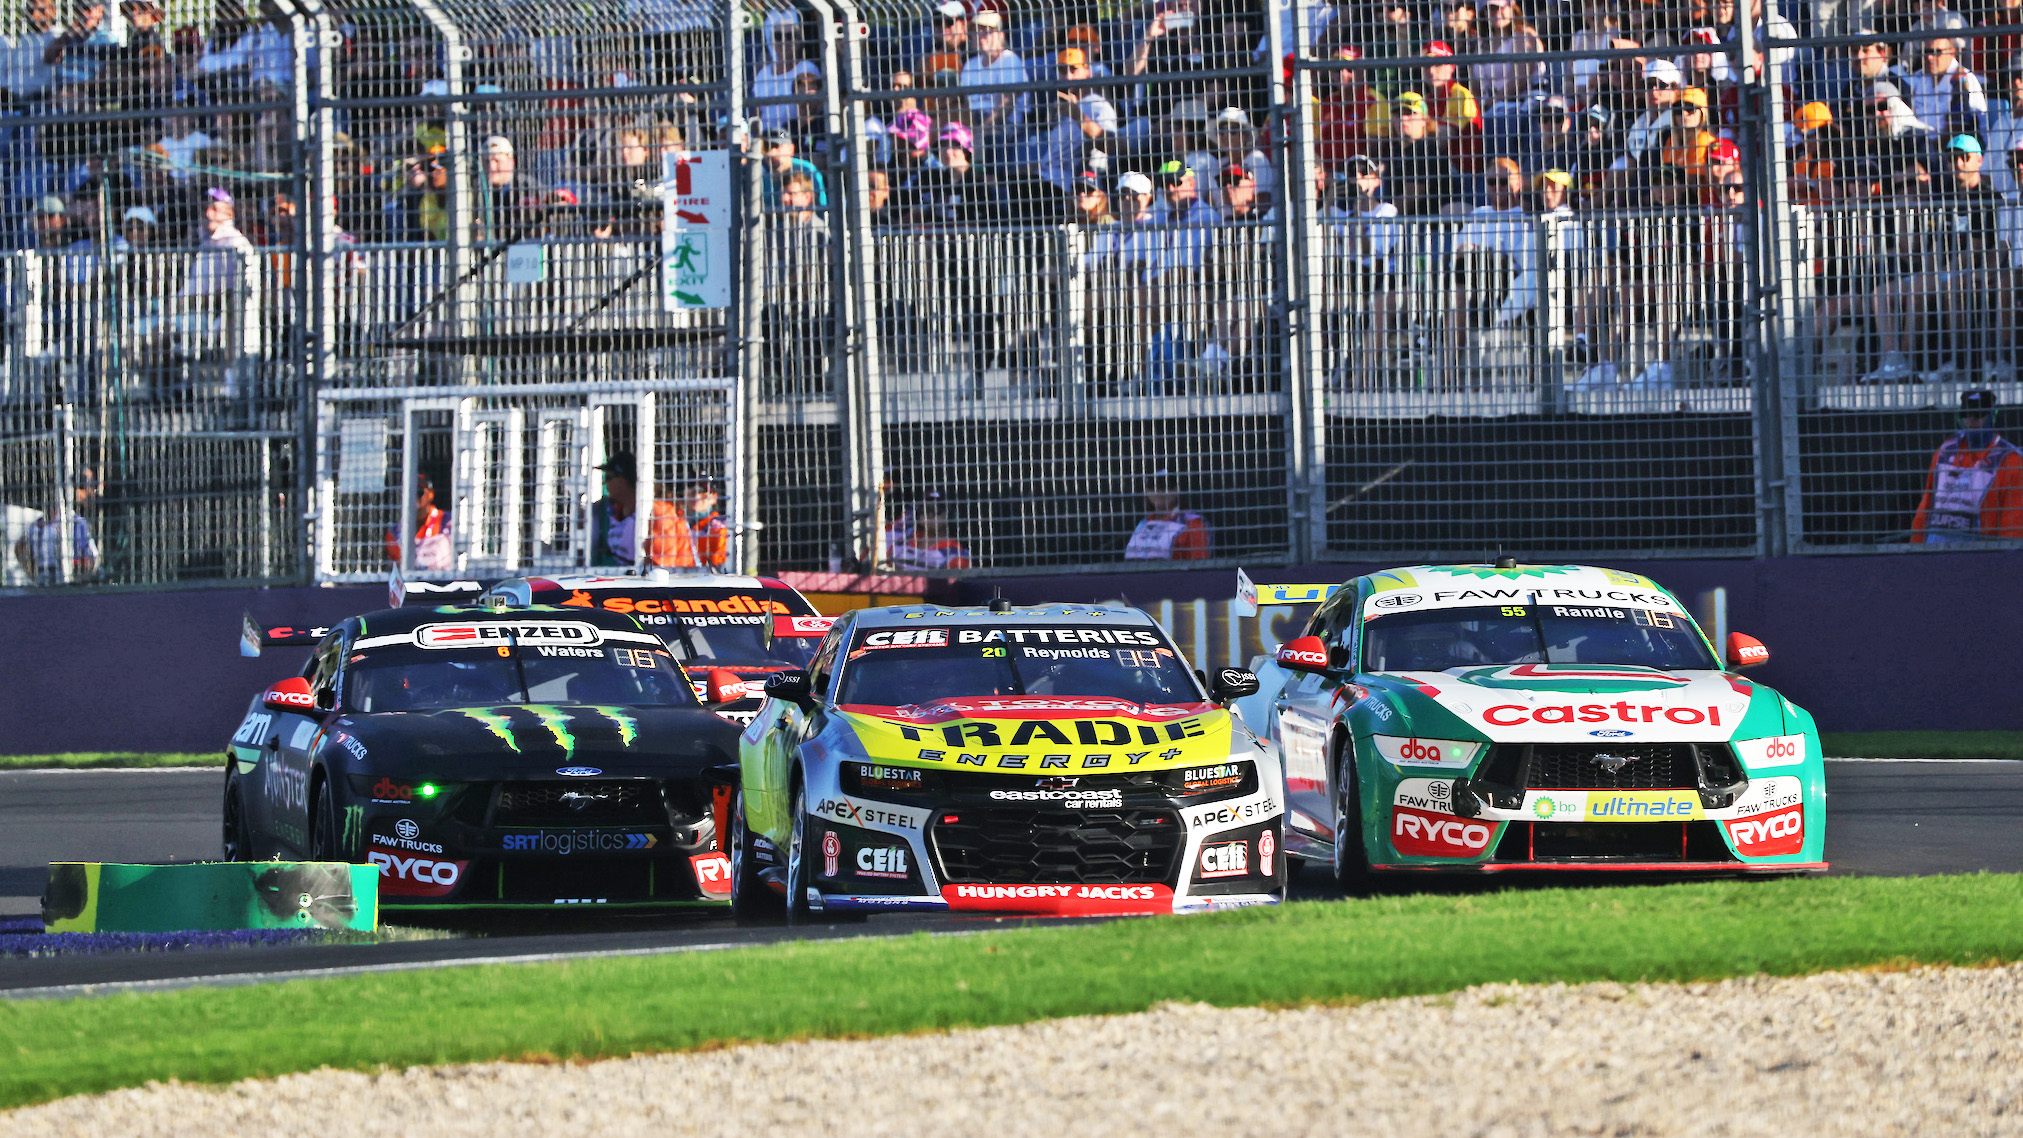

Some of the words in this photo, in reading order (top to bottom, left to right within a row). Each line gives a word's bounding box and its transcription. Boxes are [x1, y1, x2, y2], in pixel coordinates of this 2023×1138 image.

[673, 197, 710, 206] FIRE
[668, 277, 706, 286] EXIT
[602, 594, 791, 615] Scandia
[1434, 588, 1520, 602] FAW
[1526, 588, 1670, 606] TRUCKS
[638, 614, 767, 627] Heimgartner
[1500, 606, 1526, 617] 55
[1553, 606, 1625, 619] Randle
[478, 626, 583, 639] ENZED
[958, 628, 1160, 646] BATTERIES
[496, 646, 511, 658] 6
[537, 646, 604, 659] Waters
[981, 647, 1007, 658] 20
[1022, 646, 1111, 660] Reynolds
[1281, 649, 1327, 663] RYCO
[267, 691, 314, 704] RYCO
[1364, 696, 1392, 721] TRUCKS
[1482, 700, 1721, 727] Castrol
[882, 718, 1205, 747] TRADIE
[1596, 729, 1625, 737] Ford
[341, 735, 368, 760] TRUCKS
[1400, 738, 1441, 761] dba
[1766, 737, 1795, 759] dba
[860, 765, 922, 782] BLUESTAR
[1184, 779, 1209, 789] GLOBAL
[1209, 777, 1242, 787] LOGISTICS
[373, 777, 412, 799] dba
[989, 788, 1123, 801] eastcoast
[816, 796, 864, 827] APEX
[864, 809, 918, 830] STEEL
[1064, 800, 1083, 809] car
[1084, 798, 1123, 809] rentals
[1400, 794, 1429, 807] FAW
[1430, 799, 1482, 816] TRUS
[1559, 801, 1577, 815] bp
[1592, 797, 1693, 816] ultimate
[1737, 799, 1762, 816] FAW
[1763, 793, 1798, 810] TRUCKS
[1192, 804, 1246, 831] APEX
[1245, 797, 1277, 818] STEEL
[1396, 813, 1490, 849] RYCO
[1730, 810, 1801, 847] RYCO
[372, 833, 398, 847] FAW
[398, 838, 443, 854] TRUCKS
[367, 851, 459, 886] RYCO
[695, 857, 732, 884] RY
[957, 884, 1073, 899] HUNGRY
